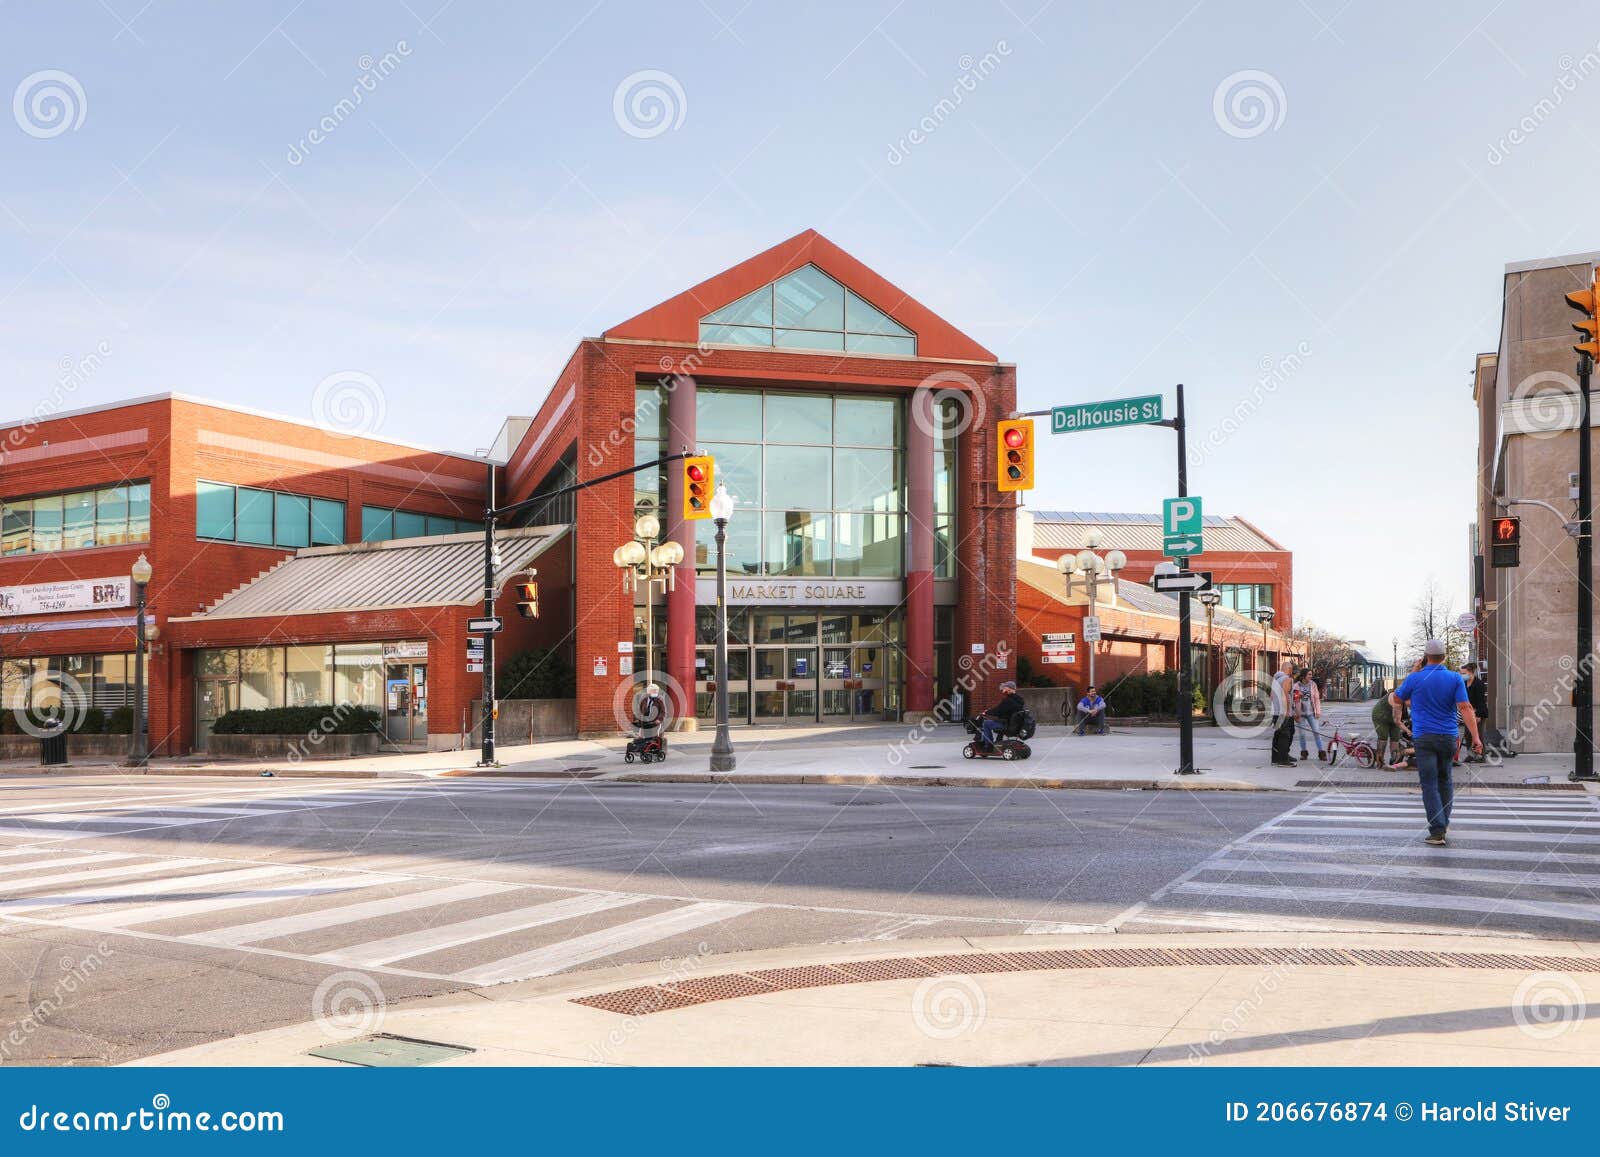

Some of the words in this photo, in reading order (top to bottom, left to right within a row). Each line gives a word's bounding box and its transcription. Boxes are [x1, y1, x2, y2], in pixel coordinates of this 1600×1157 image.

[1055, 403, 1139, 429] Dalhousie
[1142, 402, 1159, 419] St
[1170, 501, 1195, 533] P
[732, 586, 797, 599] MARKET
[804, 586, 866, 599] SQUARE
